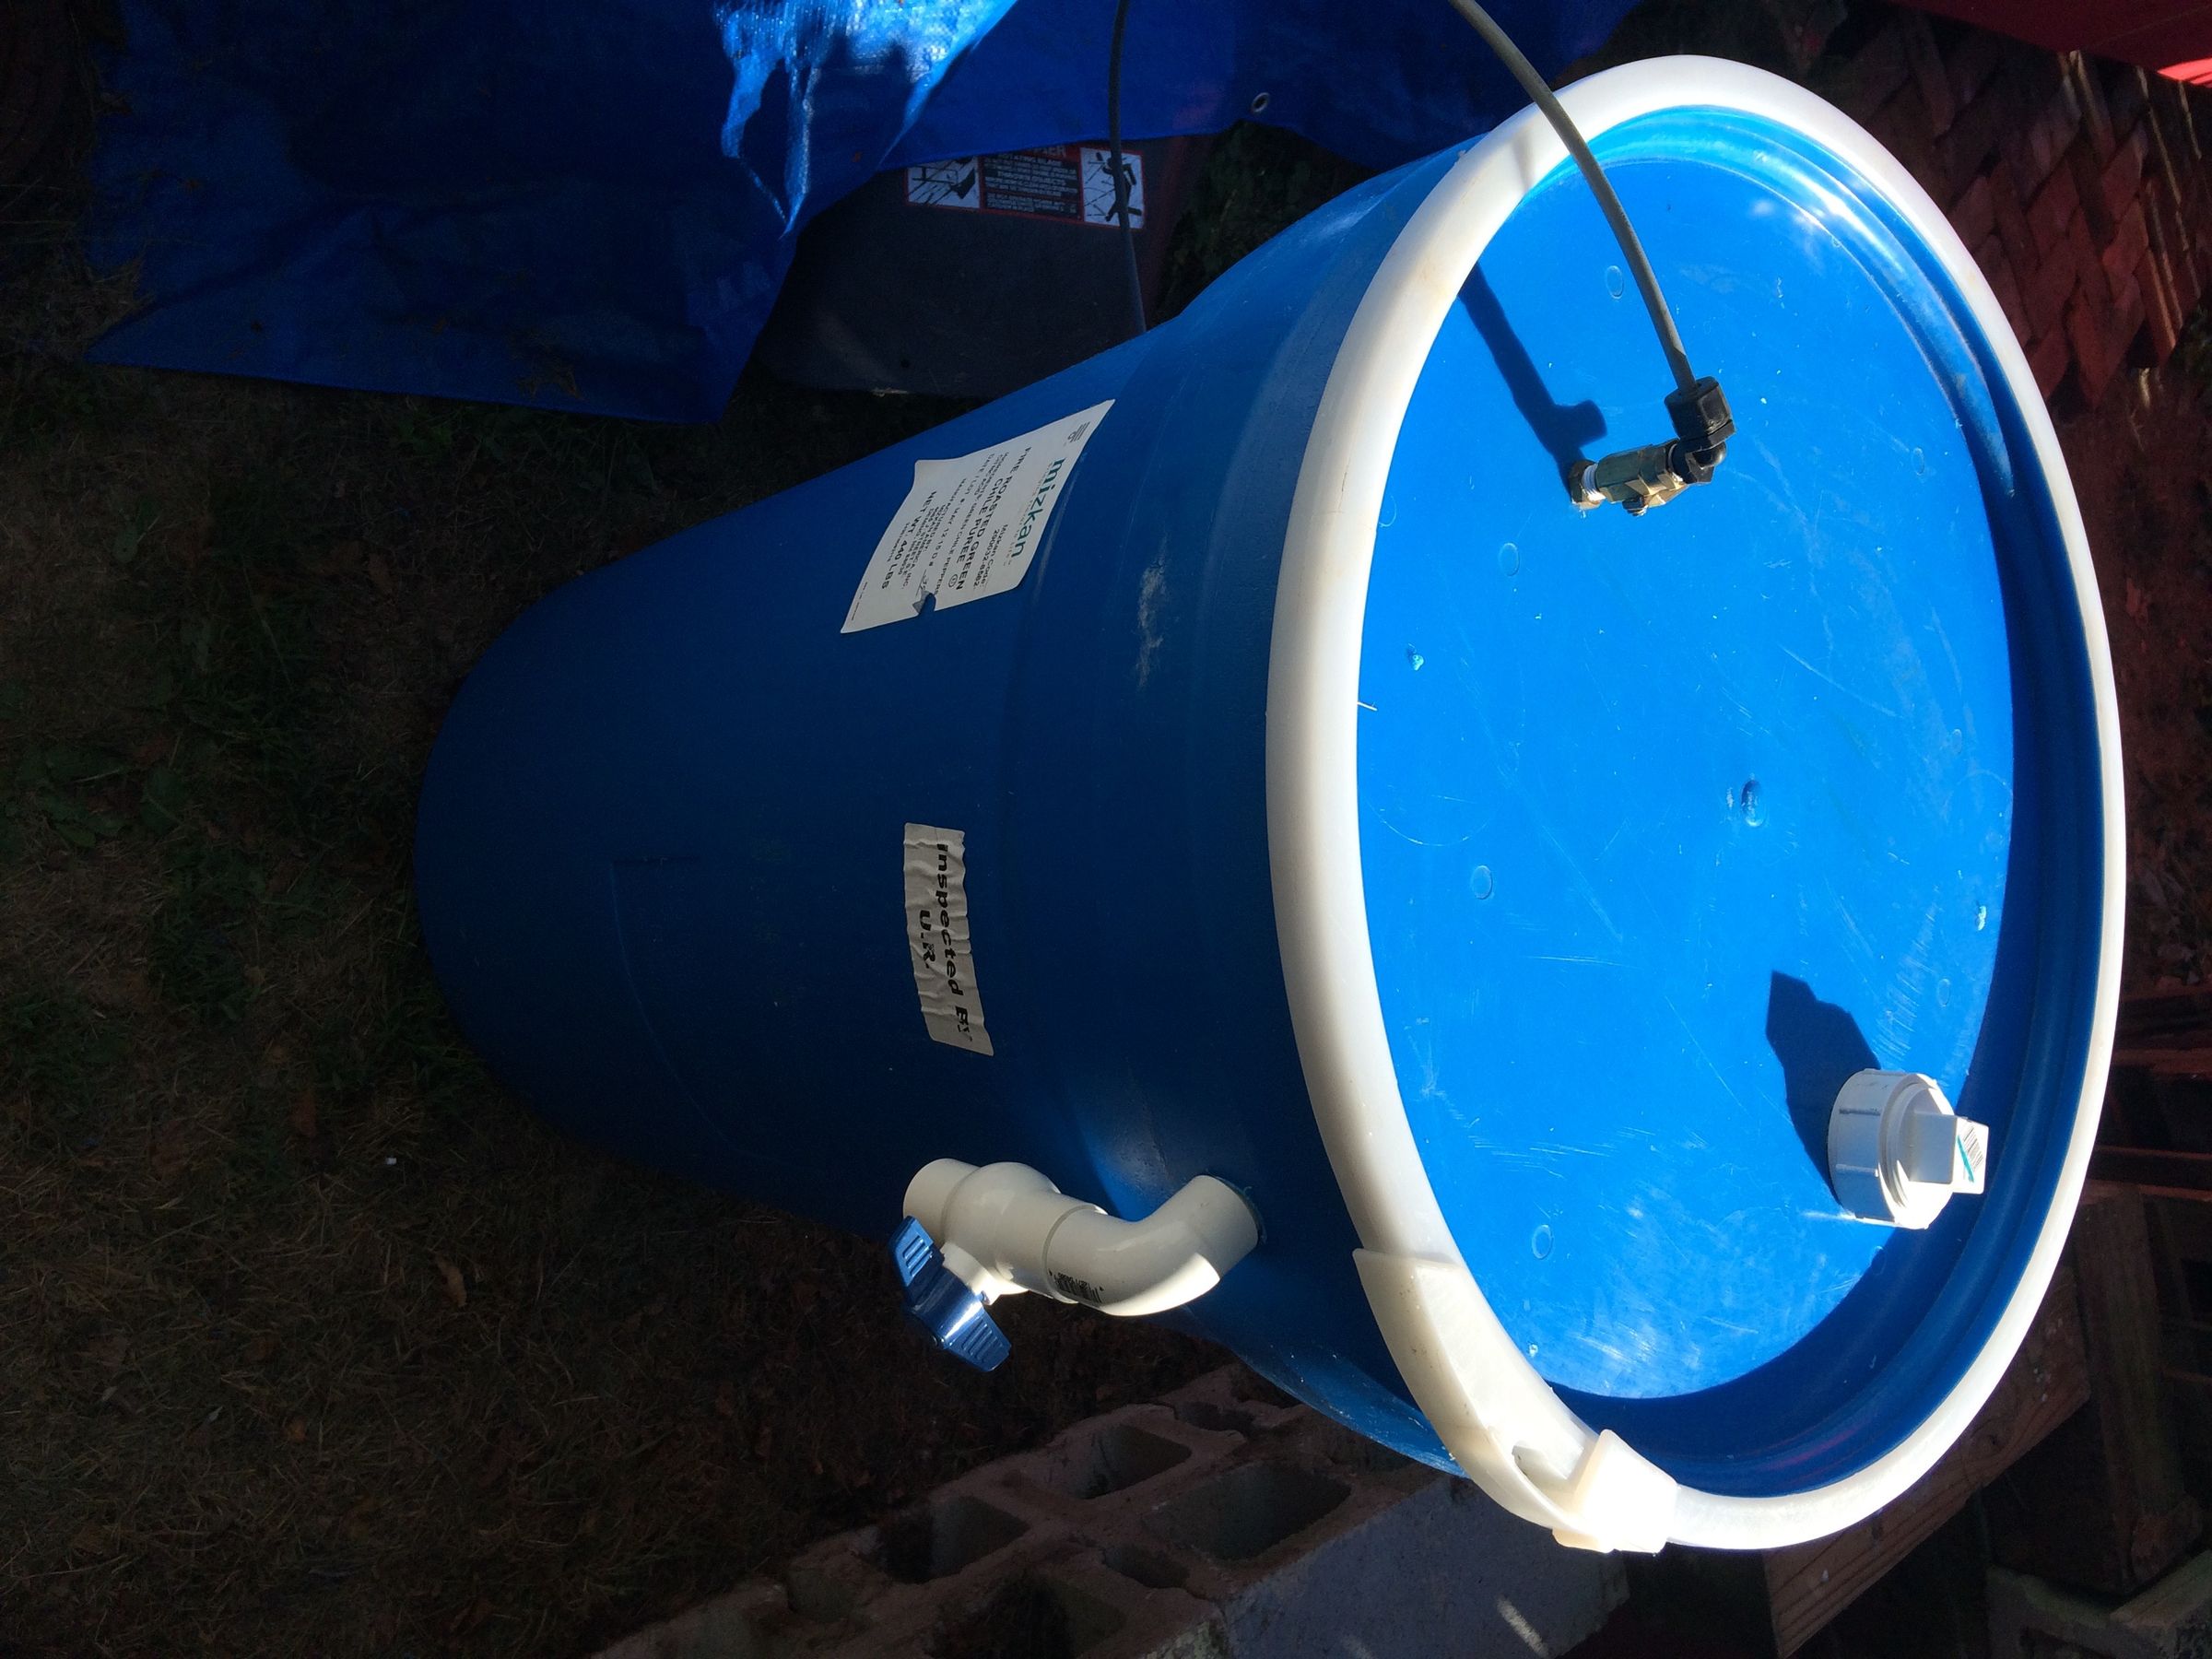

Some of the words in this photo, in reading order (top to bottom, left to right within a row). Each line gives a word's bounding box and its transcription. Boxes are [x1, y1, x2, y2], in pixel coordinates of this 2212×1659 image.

[1010, 446, 1031, 473] FIRE
[918, 490, 936, 513] NET
[975, 475, 1013, 537] ROASTED
[978, 477, 1003, 514] CHILE
[1009, 457, 1067, 558] mizkan
[904, 515, 922, 536] WT.
[959, 501, 977, 530] GREEN
[893, 538, 909, 560] 440
[947, 530, 963, 555] CHILE
[955, 517, 982, 563] PUREE
[990, 524, 1008, 557] Mizkan
[879, 562, 898, 590] LBS
[955, 540, 981, 590] GREEN
[935, 842, 965, 995] Inspected
[919, 909, 936, 970] U.R.
